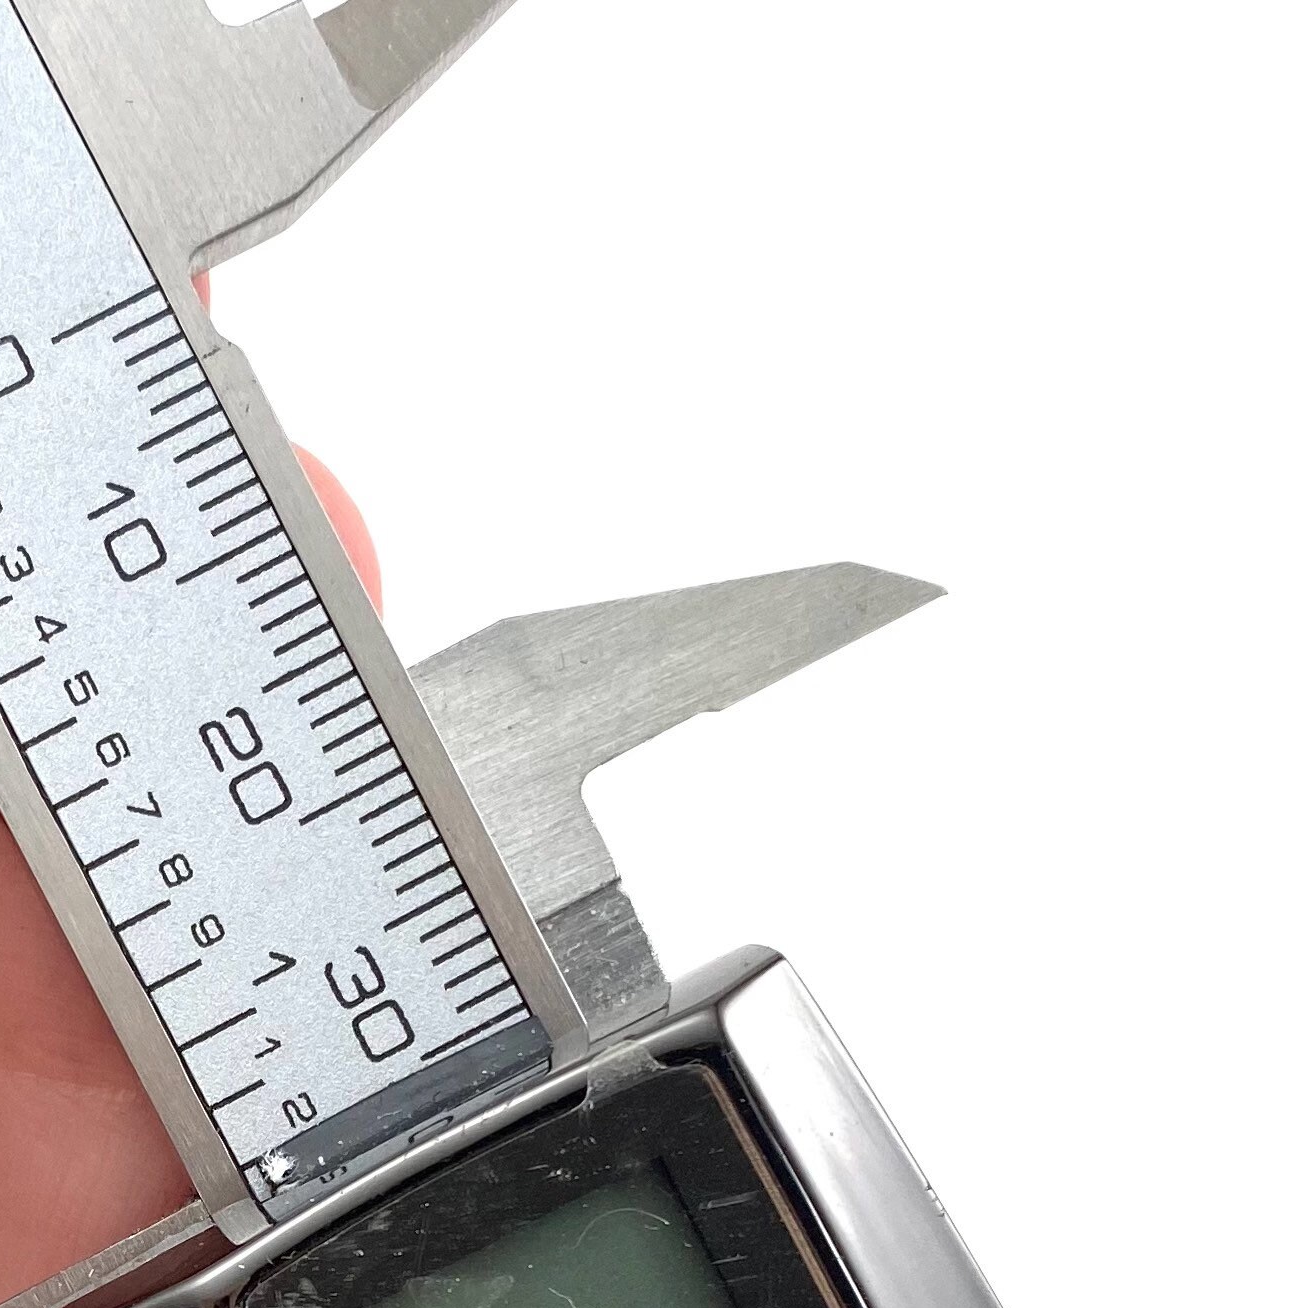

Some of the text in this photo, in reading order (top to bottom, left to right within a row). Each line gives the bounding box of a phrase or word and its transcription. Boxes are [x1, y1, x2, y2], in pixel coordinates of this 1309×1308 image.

[87, 482, 168, 582] 10
[0, 545, 35, 583] 3
[34, 614, 68, 644] 4
[63, 670, 99, 707] 5
[95, 732, 131, 768] 6
[198, 706, 293, 825] 20
[126, 791, 163, 818] 7
[158, 853, 194, 889] 8
[190, 913, 226, 949] 9
[252, 951, 297, 987] 1
[324, 945, 416, 1063] 30
[254, 1036, 282, 1060] 1
[281, 1091, 318, 1129] 2
